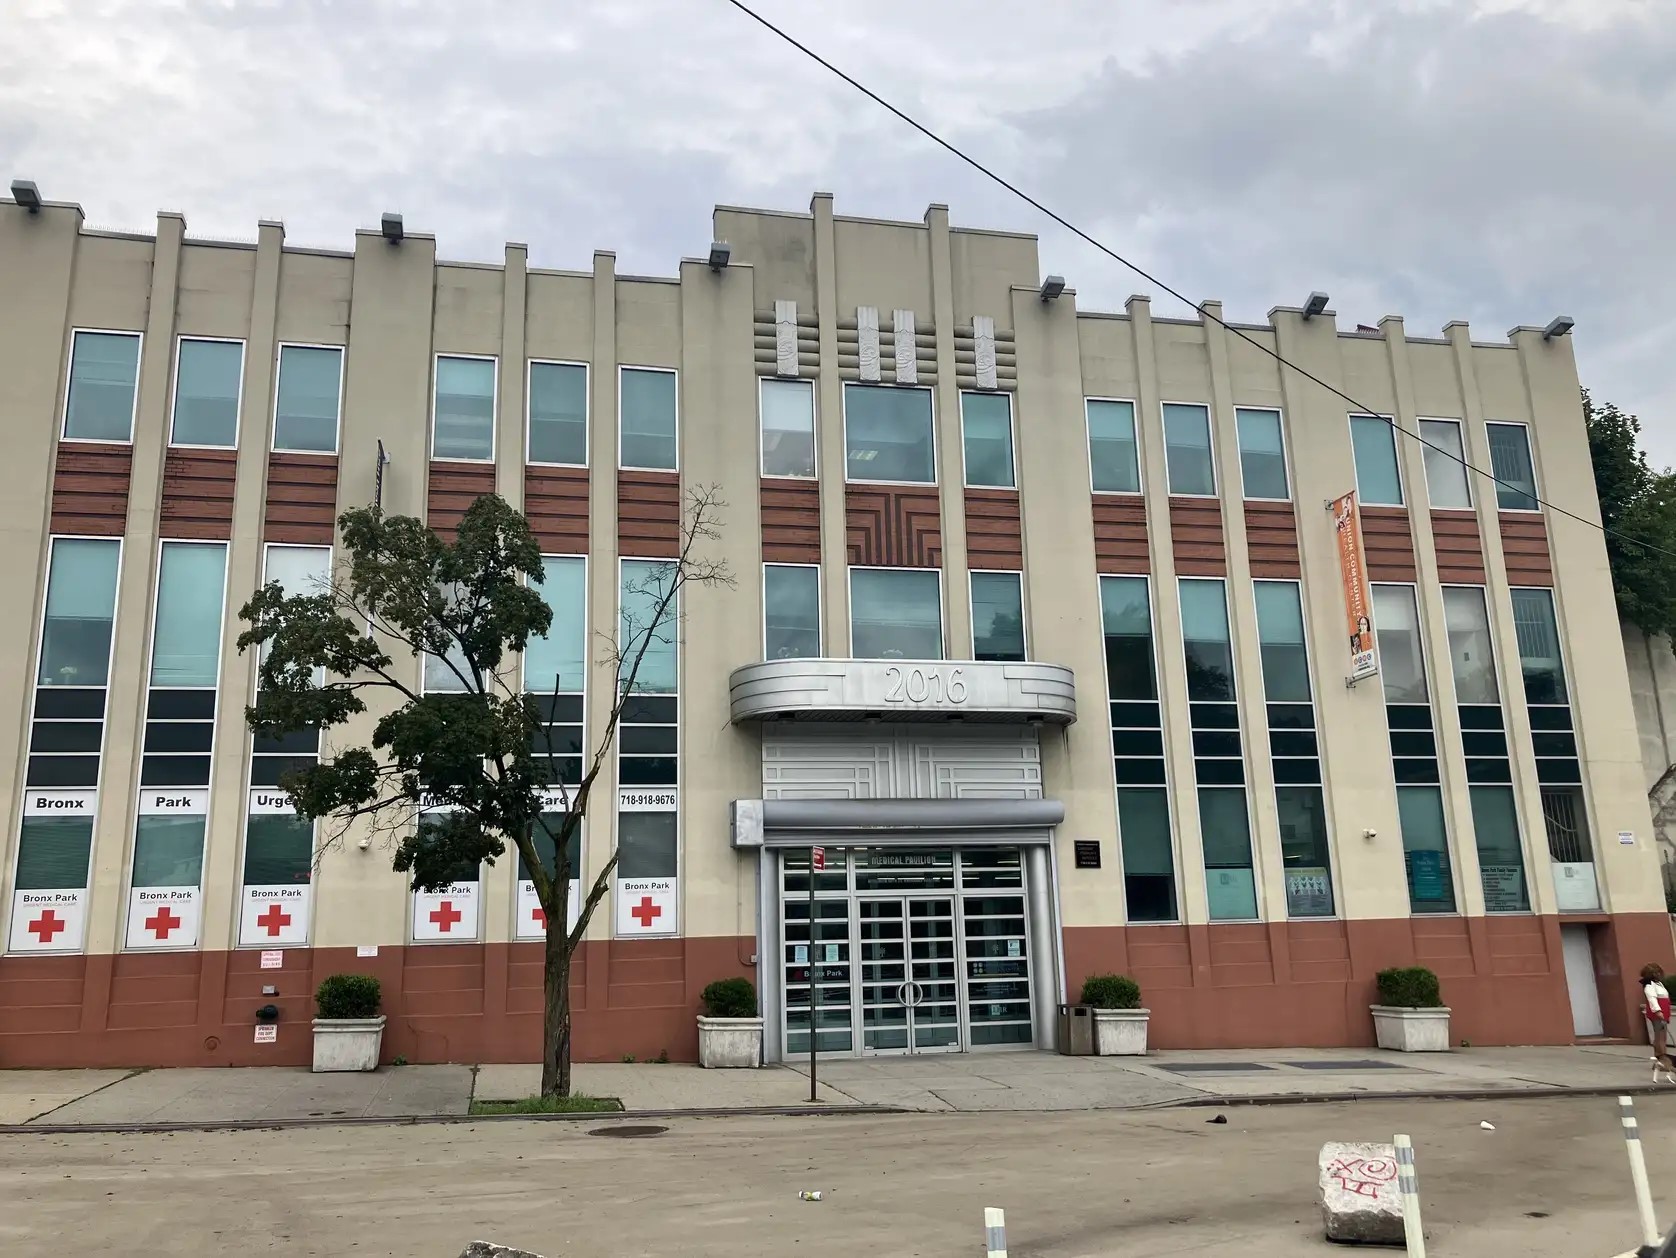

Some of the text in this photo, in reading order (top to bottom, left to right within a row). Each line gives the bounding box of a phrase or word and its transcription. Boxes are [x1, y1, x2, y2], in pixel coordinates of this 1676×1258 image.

[1345, 517, 1362, 616] UNION COMMUNITY
[884, 667, 968, 704] 2016
[36, 797, 84, 809] Bronx
[155, 796, 192, 807] Park
[257, 795, 294, 808] Urge
[621, 794, 675, 805] 718-918-9676
[871, 855, 936, 865] MEDICAL PAVILION
[451, 886, 471, 894] Park
[625, 882, 649, 890] Bronx
[23, 893, 78, 902] Bronx Park
[139, 891, 192, 900] Bronx Park
[281, 889, 302, 897] Park
[826, 969, 842, 977] Park
